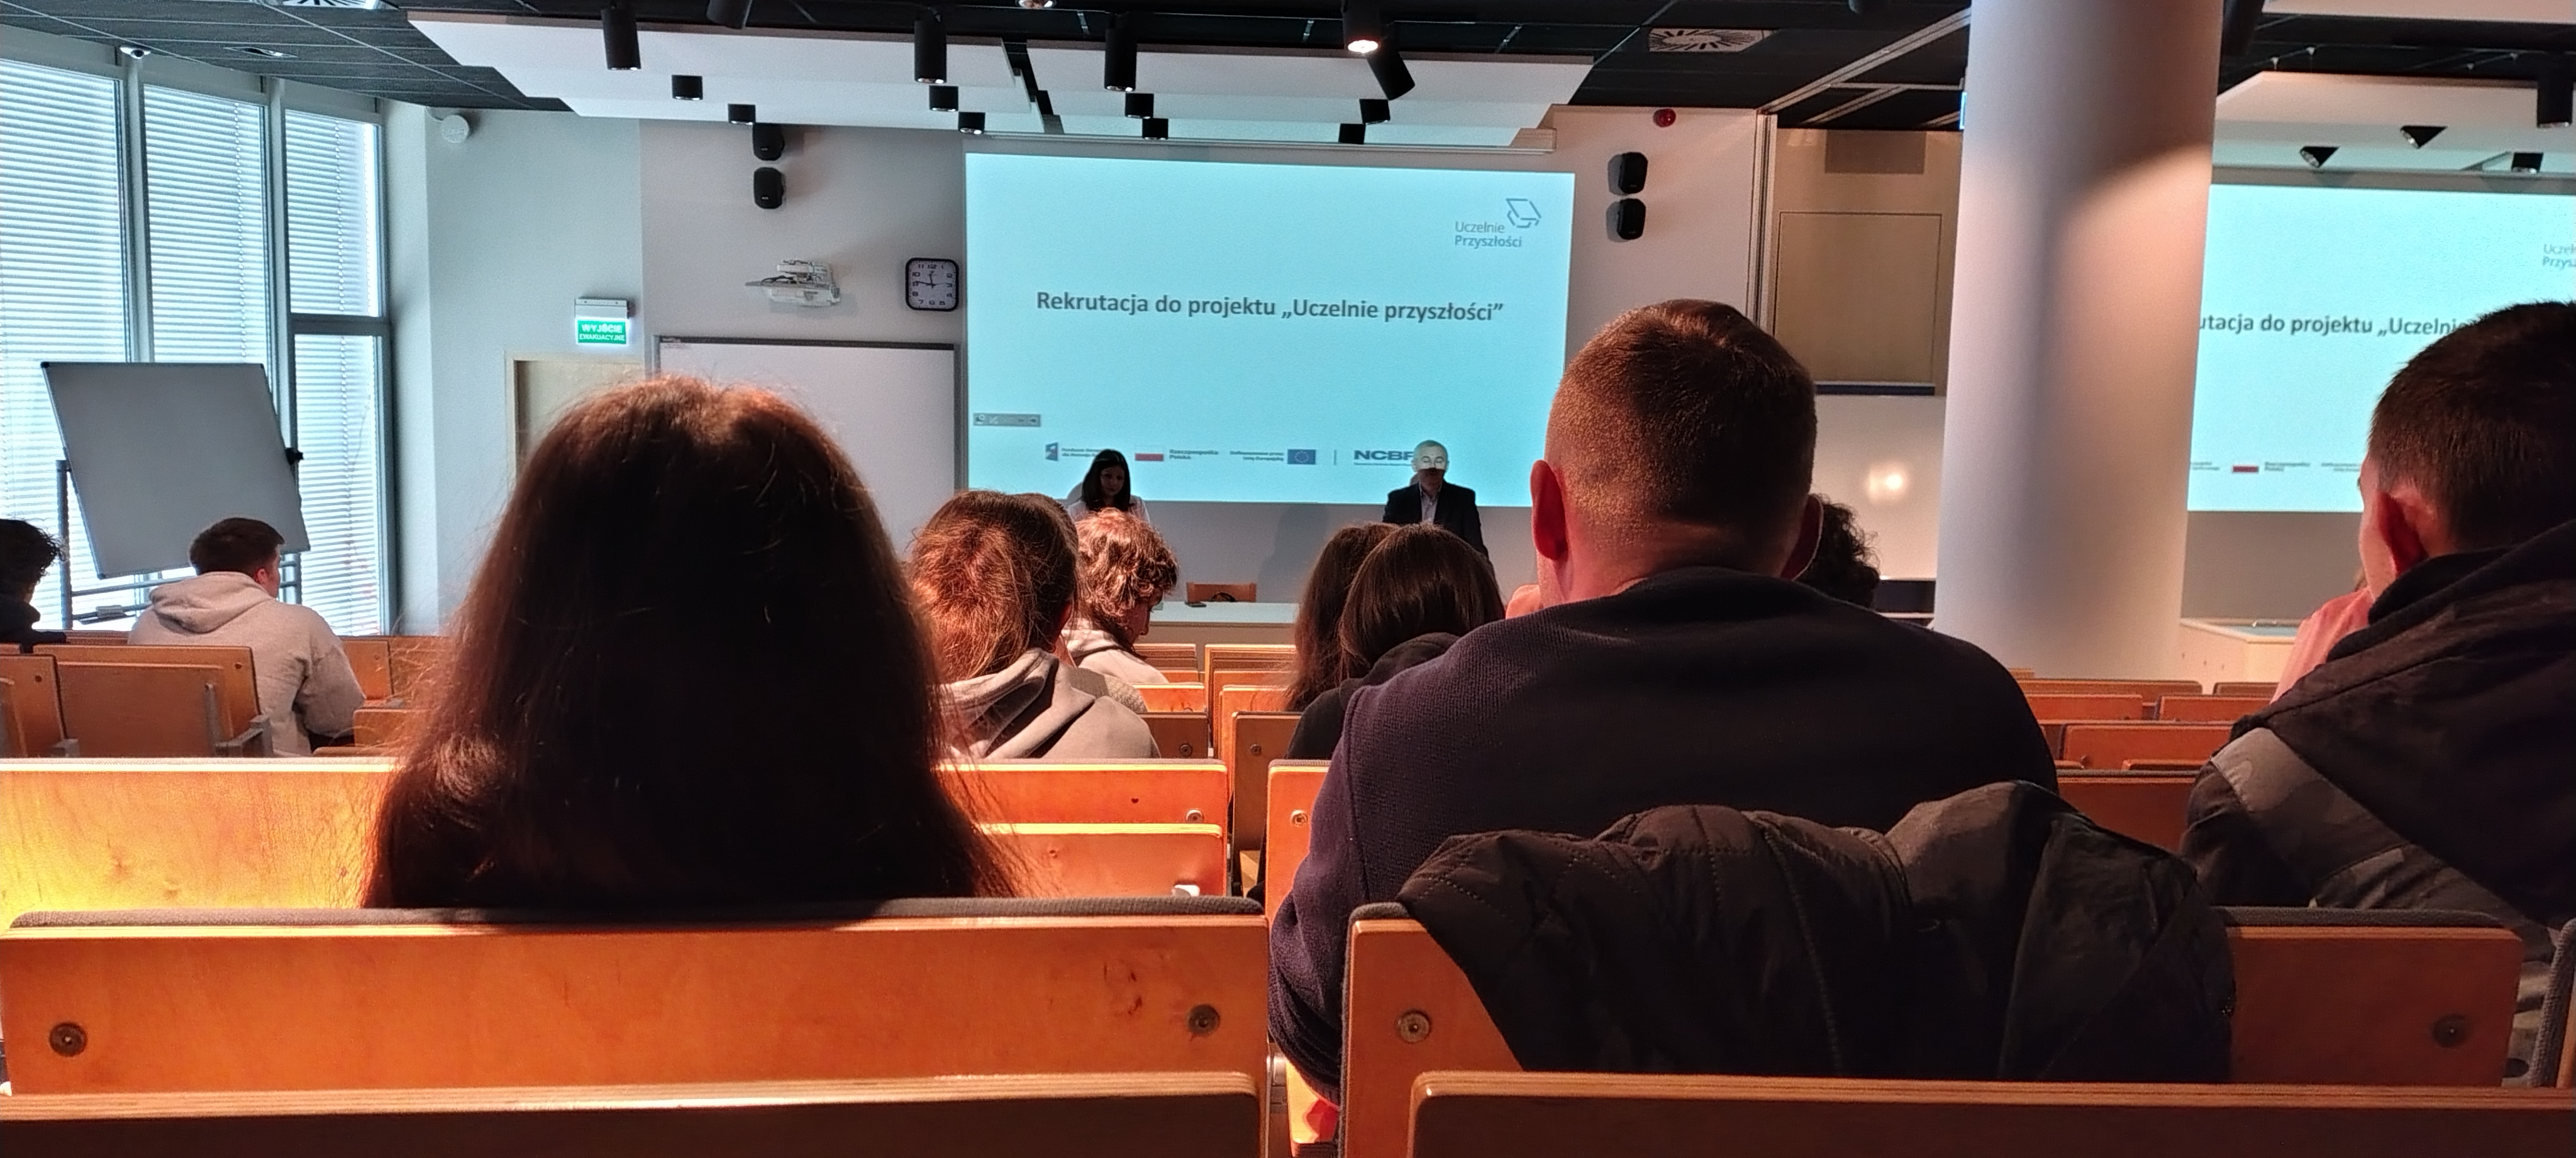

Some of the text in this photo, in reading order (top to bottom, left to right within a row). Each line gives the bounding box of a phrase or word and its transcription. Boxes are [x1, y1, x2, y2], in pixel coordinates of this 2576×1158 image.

[1455, 221, 1505, 233] Uczelnie
[1455, 235, 1522, 250] Przyszłości
[1036, 291, 1504, 323] Rekrutacja do projektu „Uczelnie przyszłości”
[581, 323, 623, 333] WYJŚCIE
[2260, 314, 2285, 332] do
[2291, 316, 2373, 336] projektu
[2377, 317, 2464, 337] „Uczelni
